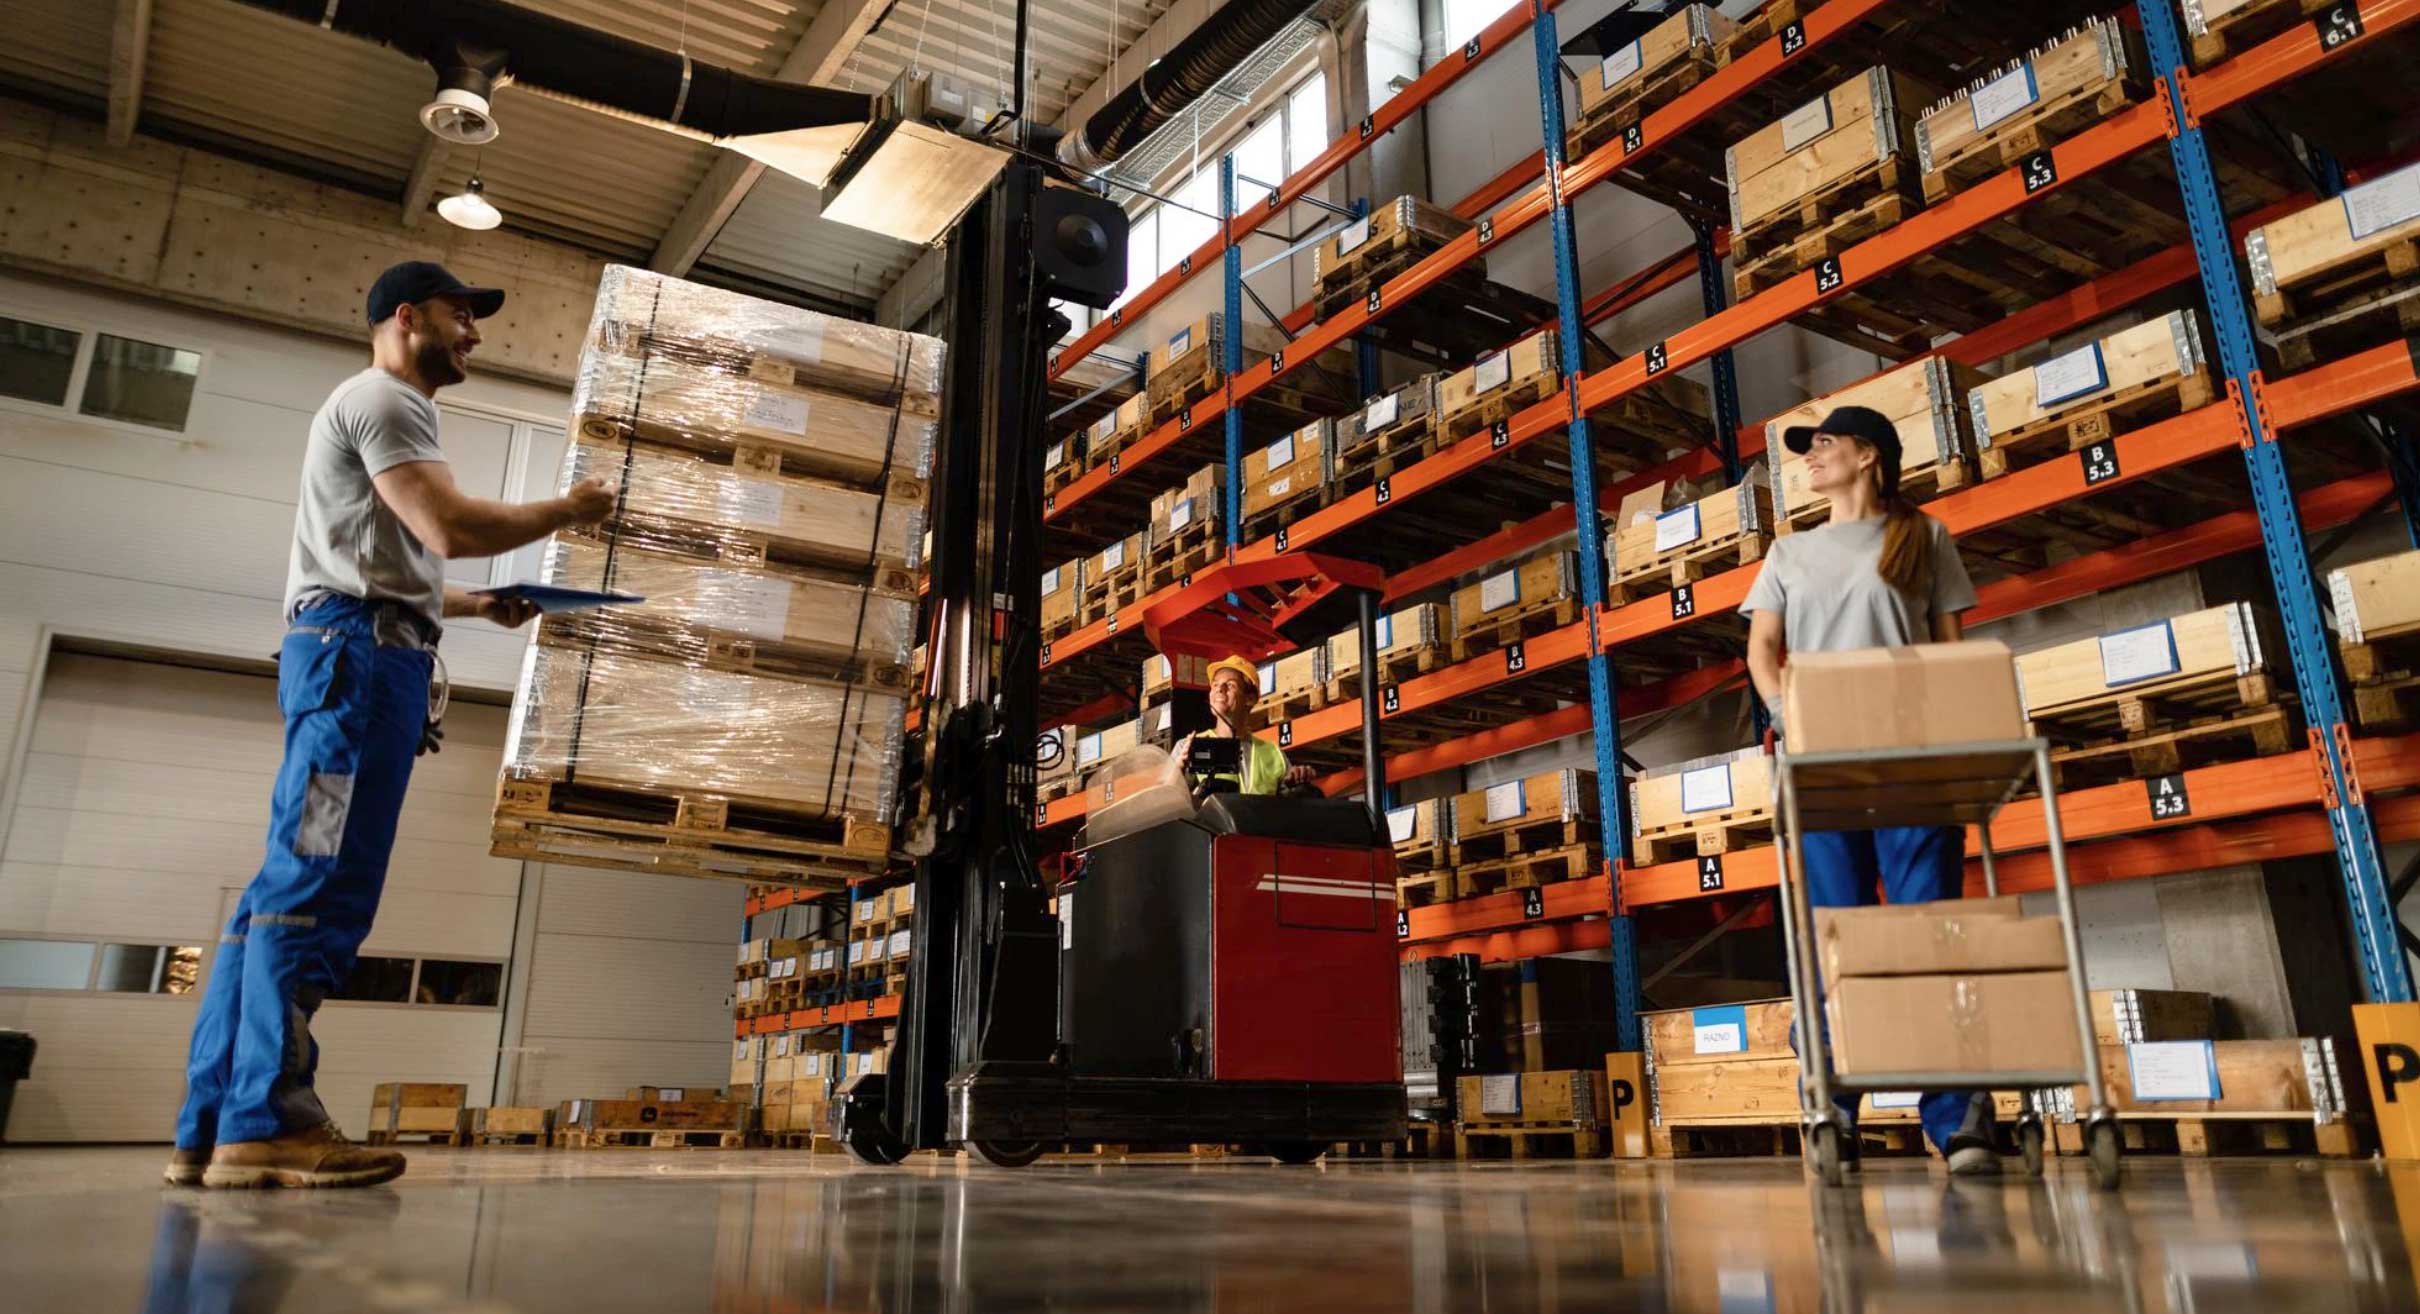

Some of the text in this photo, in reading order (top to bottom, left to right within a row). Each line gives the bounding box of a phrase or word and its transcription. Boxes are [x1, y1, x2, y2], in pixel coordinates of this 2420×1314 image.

[2331, 8, 2346, 25] C
[1787, 26, 1797, 39] D
[2327, 22, 2358, 45] 6.1
[1785, 35, 1803, 53] 5.2
[1627, 127, 1636, 140] D
[1626, 136, 1641, 153] 5.1
[2032, 156, 2042, 170] C
[2029, 169, 2051, 190] 5.3
[1482, 221, 1489, 232] D
[1480, 229, 1492, 243] 4.3
[1823, 260, 1833, 274] C
[1820, 273, 1839, 291] 5.2
[1371, 291, 1378, 301] D
[1652, 345, 1660, 357] C
[1650, 359, 1665, 373] 5.1
[1497, 423, 1503, 433] C
[1494, 433, 1506, 446] 4.3
[2091, 447, 2104, 462] B
[2089, 461, 2114, 480] 5.3
[1380, 480, 1386, 490] C
[1377, 490, 1389, 502] 4.2
[1279, 530, 1284, 540] C
[1277, 539, 1287, 550] 4.1
[1678, 589, 1687, 601] B
[1675, 601, 1692, 617] 5.1
[1511, 646, 1519, 657] B
[1509, 656, 1524, 670] 4.3
[1388, 688, 1394, 699] B
[1386, 699, 1397, 711] 4.2
[2159, 777, 2174, 796] A
[2156, 796, 2184, 817] 5.3
[1706, 858, 1716, 872] A
[1703, 873, 1721, 888] 5.1
[1530, 890, 1538, 901] A
[1527, 903, 1542, 916] 4.3
[1397, 912, 1404, 923] A
[2373, 1043, 2420, 1103] P
[1612, 1079, 1634, 1121] P
